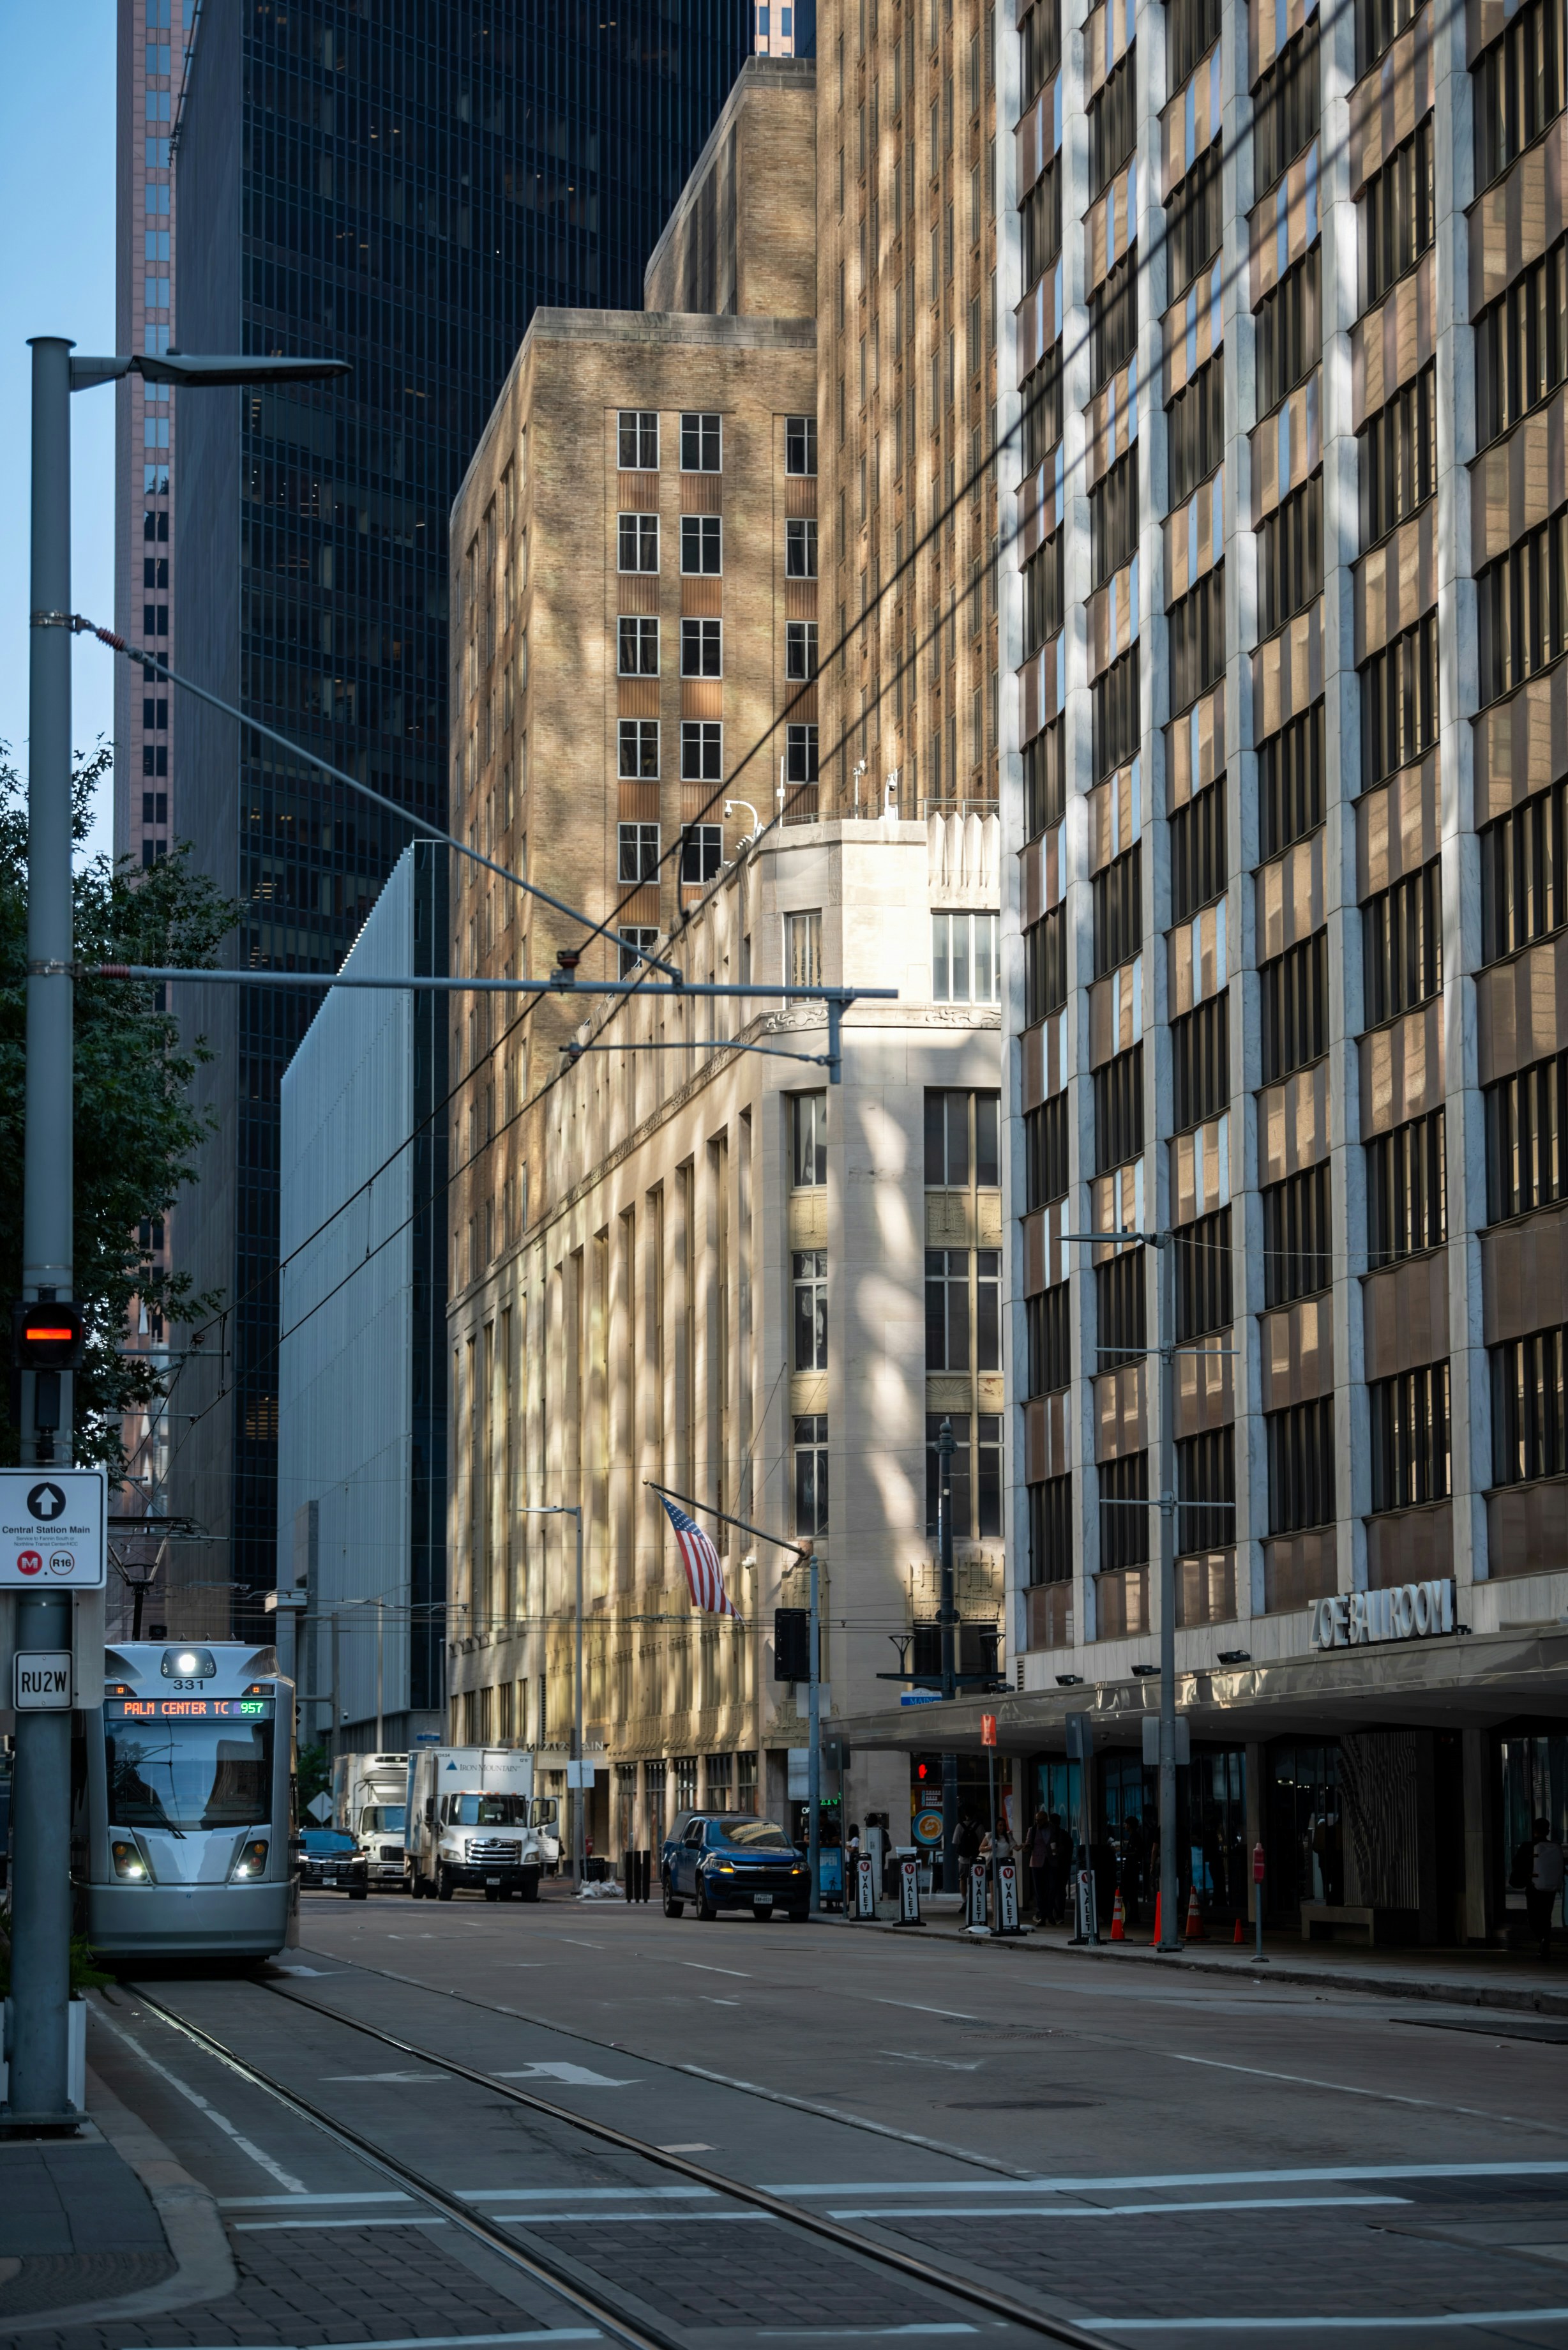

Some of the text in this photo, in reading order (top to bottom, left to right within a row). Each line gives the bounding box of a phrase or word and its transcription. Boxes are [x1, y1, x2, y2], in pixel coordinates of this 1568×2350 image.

[52, 1559, 72, 1567] R16
[1308, 1579, 1452, 1649] ZOE BALLROOM
[22, 1671, 67, 1693] RU2W
[173, 1679, 204, 1690] 331
[124, 1702, 155, 1715] PALM
[162, 1702, 206, 1715] CENTER
[214, 1702, 229, 1715] TC
[582, 1741, 604, 1751] AIN
[478, 1764, 517, 1772] MOUNTAIN
